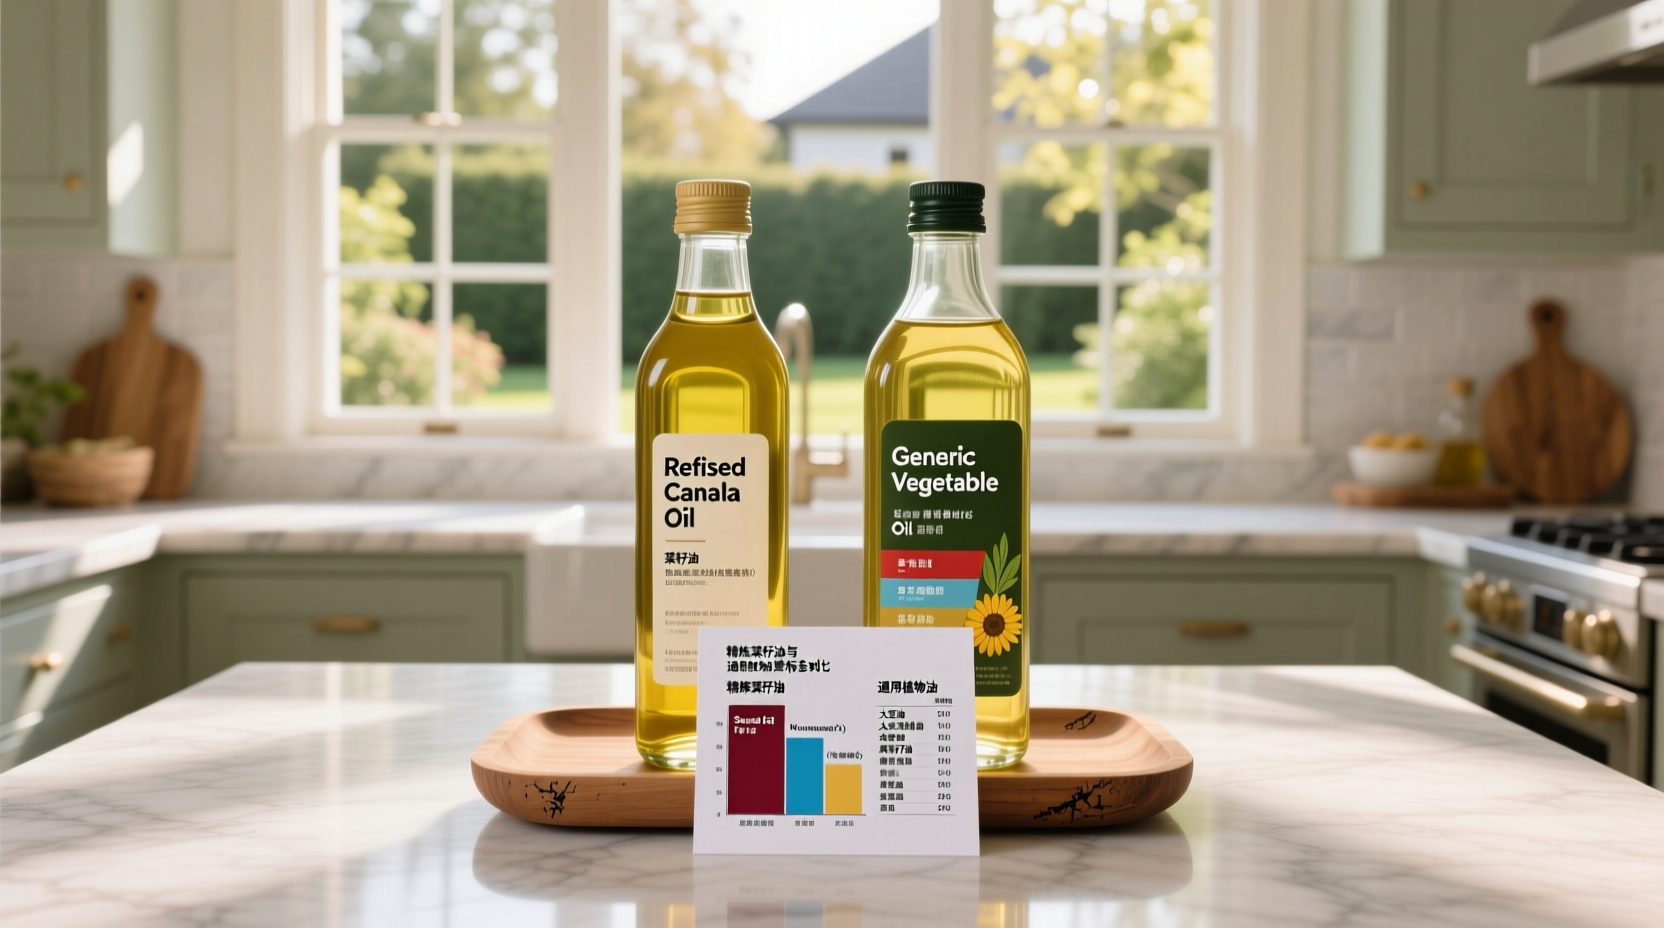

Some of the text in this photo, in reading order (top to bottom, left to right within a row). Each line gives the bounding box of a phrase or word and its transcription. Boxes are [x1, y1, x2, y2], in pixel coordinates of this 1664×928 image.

[664, 456, 746, 477] Refised
[891, 445, 976, 467] Generic
[664, 481, 741, 503] Canala
[891, 471, 999, 498] Vegetable
[664, 506, 695, 528] Oil
